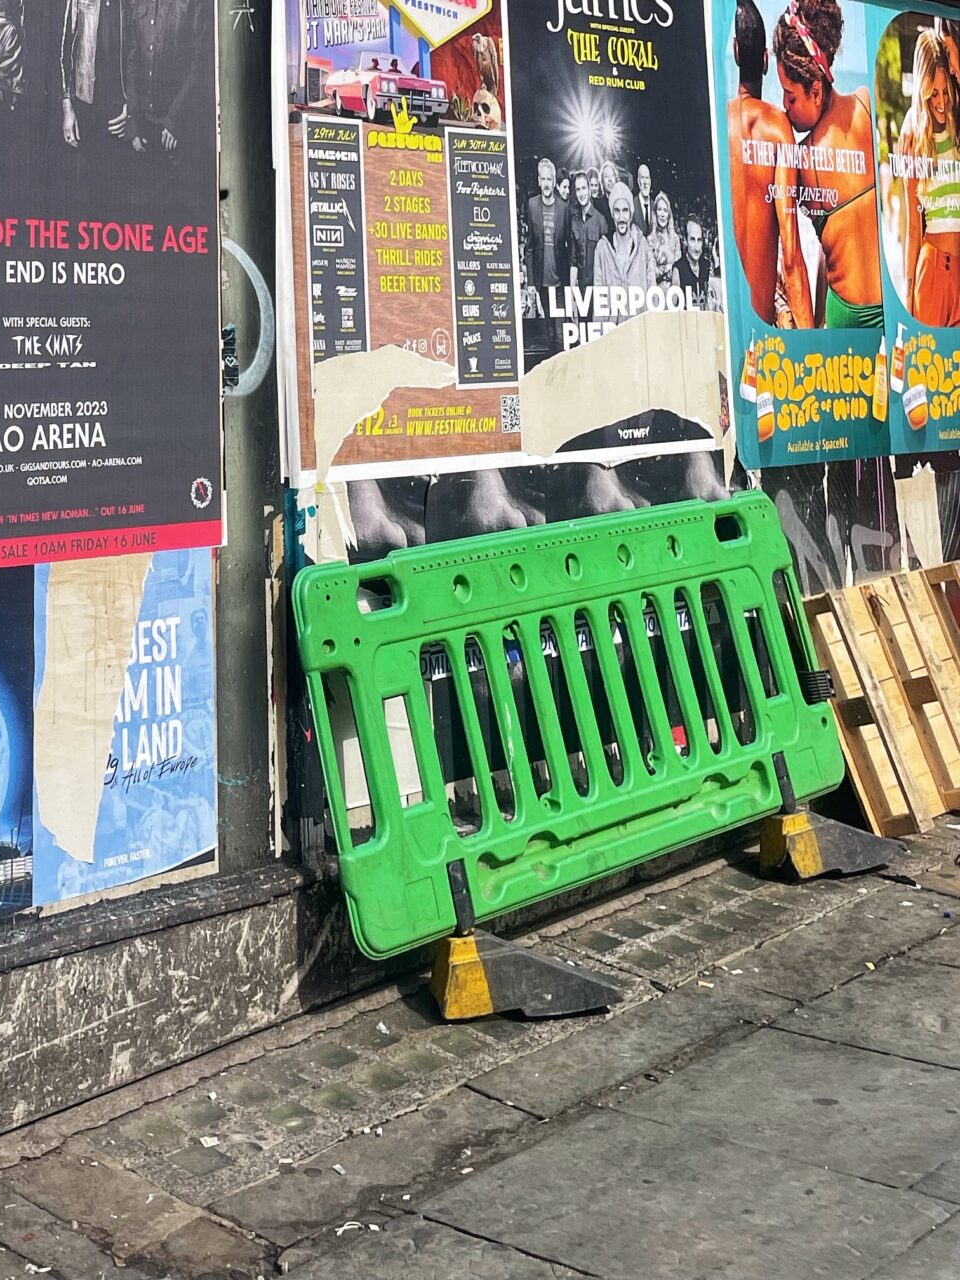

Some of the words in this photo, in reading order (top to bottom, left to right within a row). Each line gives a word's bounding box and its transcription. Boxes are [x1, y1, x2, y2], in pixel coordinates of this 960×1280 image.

[324, 20, 366, 47] MARY'S
[367, 19, 387, 39] PARK
[567, 28, 601, 65] THE
[607, 36, 658, 71] CORAL
[588, 75, 605, 86] RED
[606, 77, 624, 88] RUM
[624, 79, 646, 91] CLUB
[313, 127, 336, 140] 29TH
[337, 129, 357, 141] JULY
[452, 138, 467, 150] SUN
[469, 139, 487, 151] 30TH
[488, 141, 506, 152] JULY
[777, 142, 809, 170] ALWAYS
[809, 146, 835, 173] FEELS
[835, 148, 867, 175] BETTER
[888, 152, 914, 179] TOUCH
[331, 172, 356, 191] ROSES
[389, 169, 397, 186] 2
[399, 171, 424, 187] DAYS
[471, 181, 506, 198] Fighters
[796, 186, 839, 207] JANEIRO
[384, 195, 391, 212] 2
[393, 197, 431, 214] STAGES
[473, 206, 491, 222] ELO
[25, 219, 69, 249] THE
[78, 222, 154, 252] STONE
[161, 225, 209, 254] AGE
[368, 221, 388, 239] +30
[390, 222, 413, 239] LIVE
[415, 224, 448, 241] BANDS
[376, 248, 412, 266] THRILL
[414, 250, 443, 267] RIDES
[5, 260, 45, 284] END
[52, 261, 67, 284] IS
[73, 263, 126, 285] NERO
[379, 276, 407, 293] BEER
[408, 276, 441, 293] TENTS
[548, 284, 701, 318] LIVERPOOL
[2, 317, 24, 328] WITH
[25, 317, 58, 328] SPECIAL
[60, 317, 91, 328] GUESTS:
[11, 335, 42, 356] THE
[45, 333, 83, 357] CHATS
[4, 403, 73, 419] NOVEMBER
[76, 401, 108, 416] 2023
[407, 407, 423, 418] BOOK
[424, 407, 445, 417] TICKETS
[445, 406, 465, 416] ONLINE
[777, 394, 821, 432] STATE
[32, 422, 107, 451] ARENA
[406, 417, 497, 437] WWW.FESTWICH.COM
[787, 438, 814, 454] Available
[20, 459, 87, 472] GIGSANDTOURS.COM
[91, 457, 143, 468] AO-ARENA.COM
[26, 475, 68, 486] QOTSA.COM
[19, 513, 40, 523] TIMES
[42, 511, 58, 521] NEW
[100, 506, 116, 516] OUT
[128, 504, 145, 514] JUNE
[1, 544, 28, 559] SALE
[33, 541, 67, 557] 10AM
[70, 536, 109, 553] FRIDAY
[113, 534, 127, 549] 16
[131, 532, 156, 547] JUNE
[155, 665, 182, 717] IN
[122, 720, 183, 771] LAND
[158, 754, 199, 782] Europe
